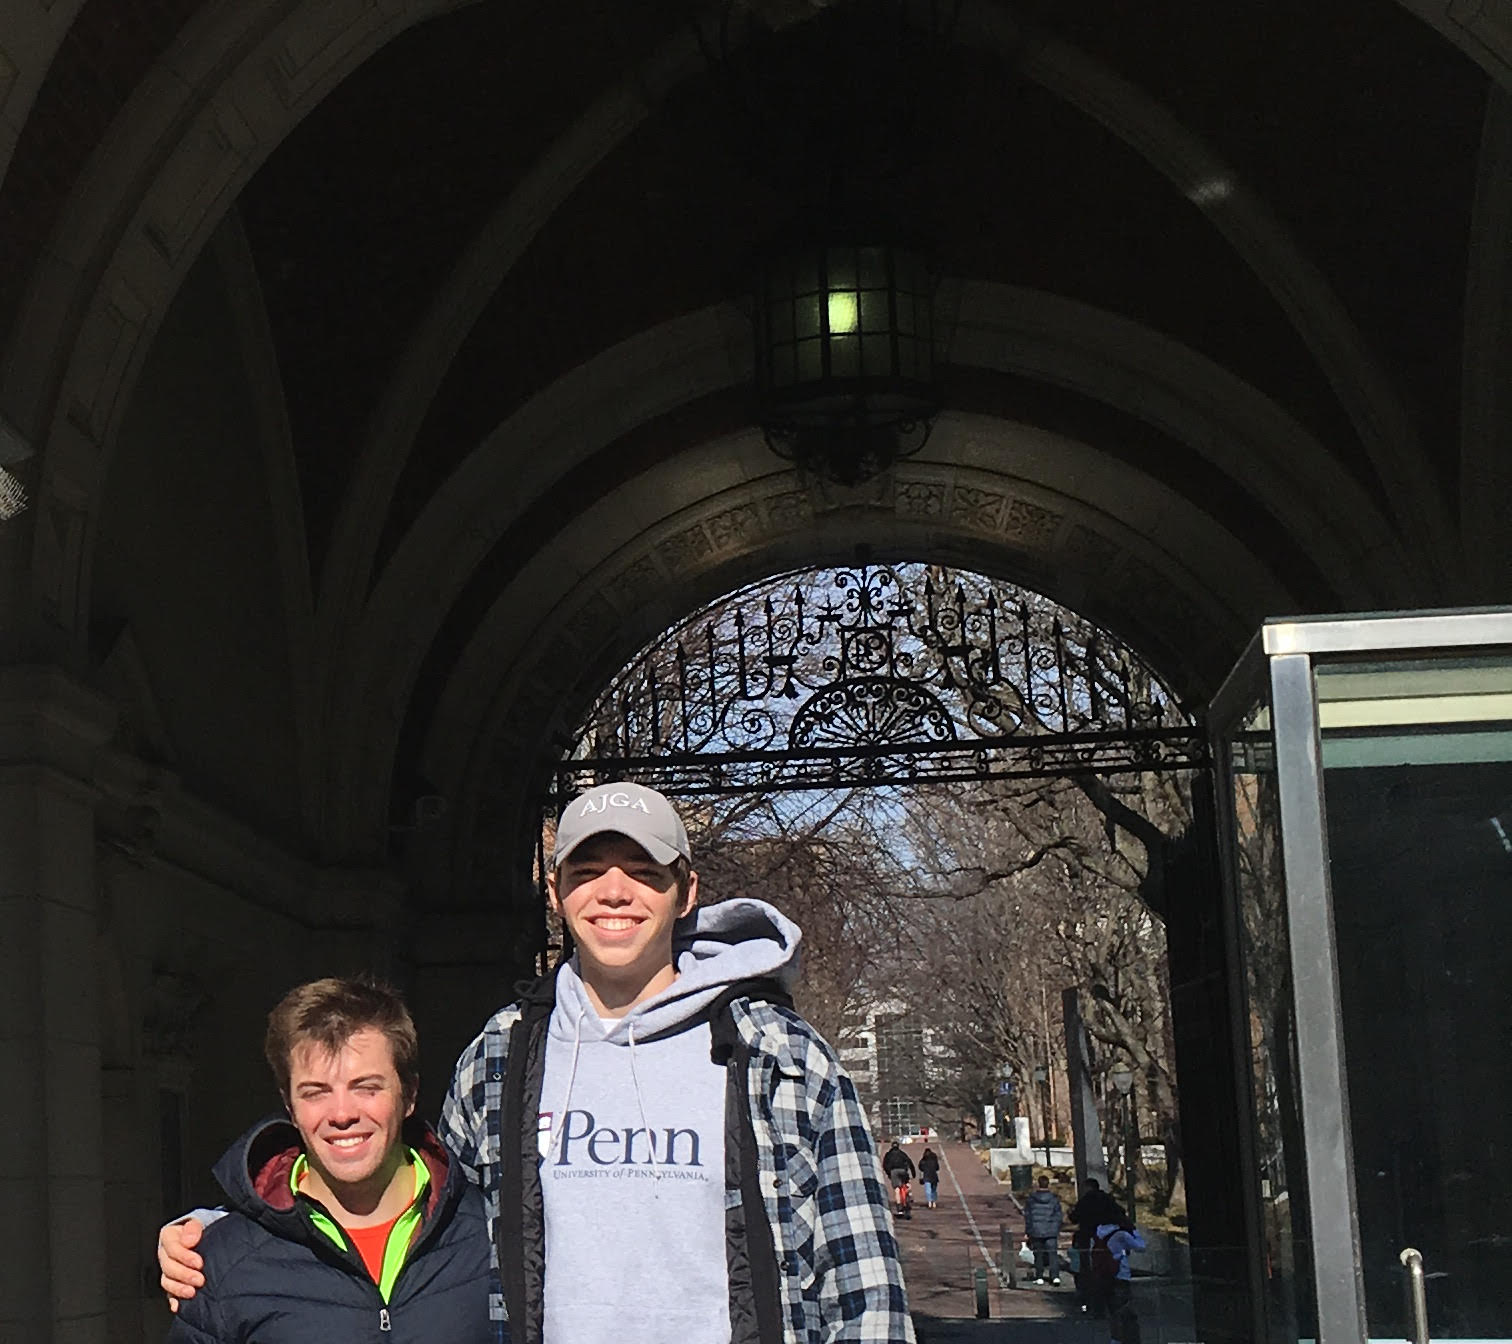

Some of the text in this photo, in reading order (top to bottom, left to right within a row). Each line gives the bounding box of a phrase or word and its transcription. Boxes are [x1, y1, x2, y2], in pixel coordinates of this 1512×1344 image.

[579, 792, 651, 817] AJGA
[554, 1109, 703, 1167] Penn
[553, 1168, 705, 1181] UNIVERSITY of PENNYLVANIA
